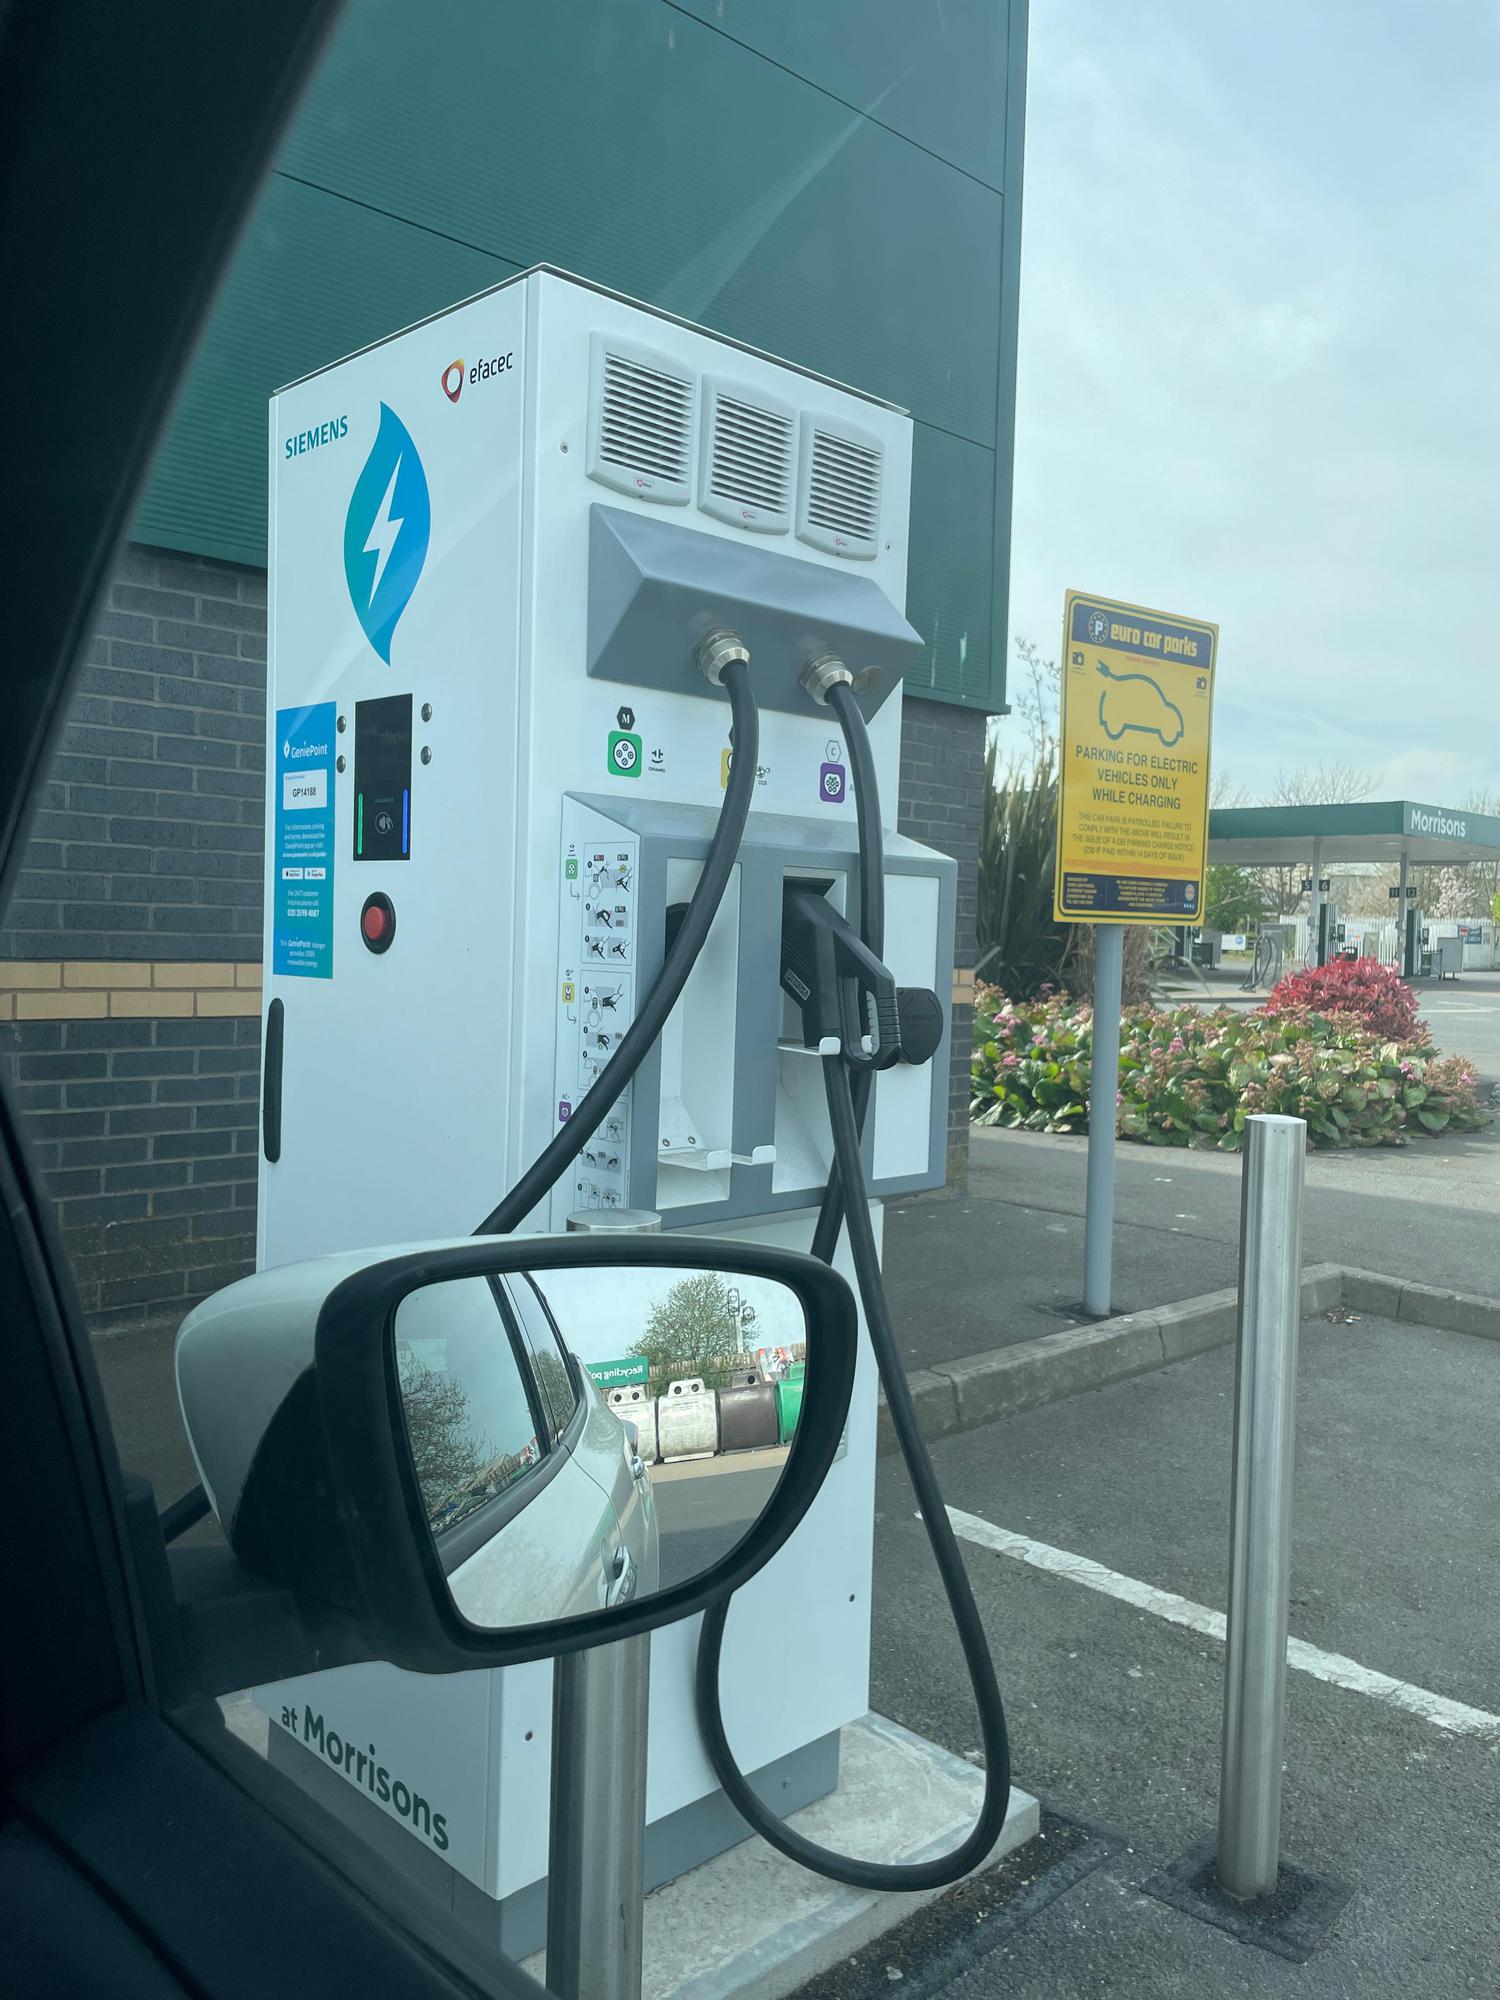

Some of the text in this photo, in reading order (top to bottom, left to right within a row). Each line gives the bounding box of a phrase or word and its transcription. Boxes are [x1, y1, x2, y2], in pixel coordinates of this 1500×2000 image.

[469, 352, 513, 384] efacec
[285, 415, 348, 460] SIEMENS
[1094, 620, 1103, 636] P
[1111, 624, 1198, 658] euro car parks
[291, 741, 328, 759] GeniePoint
[1076, 744, 1198, 774] PARKING FOR ELECTRIC
[1098, 768, 1178, 791] VEHICLES ONLY
[1092, 788, 1180, 810] WHILE CHARGING
[1411, 808, 1466, 838] Morrisons
[1304, 880, 1310, 889] 5
[1322, 880, 1328, 889] 6
[281, 1704, 449, 1851] at Morrisons
